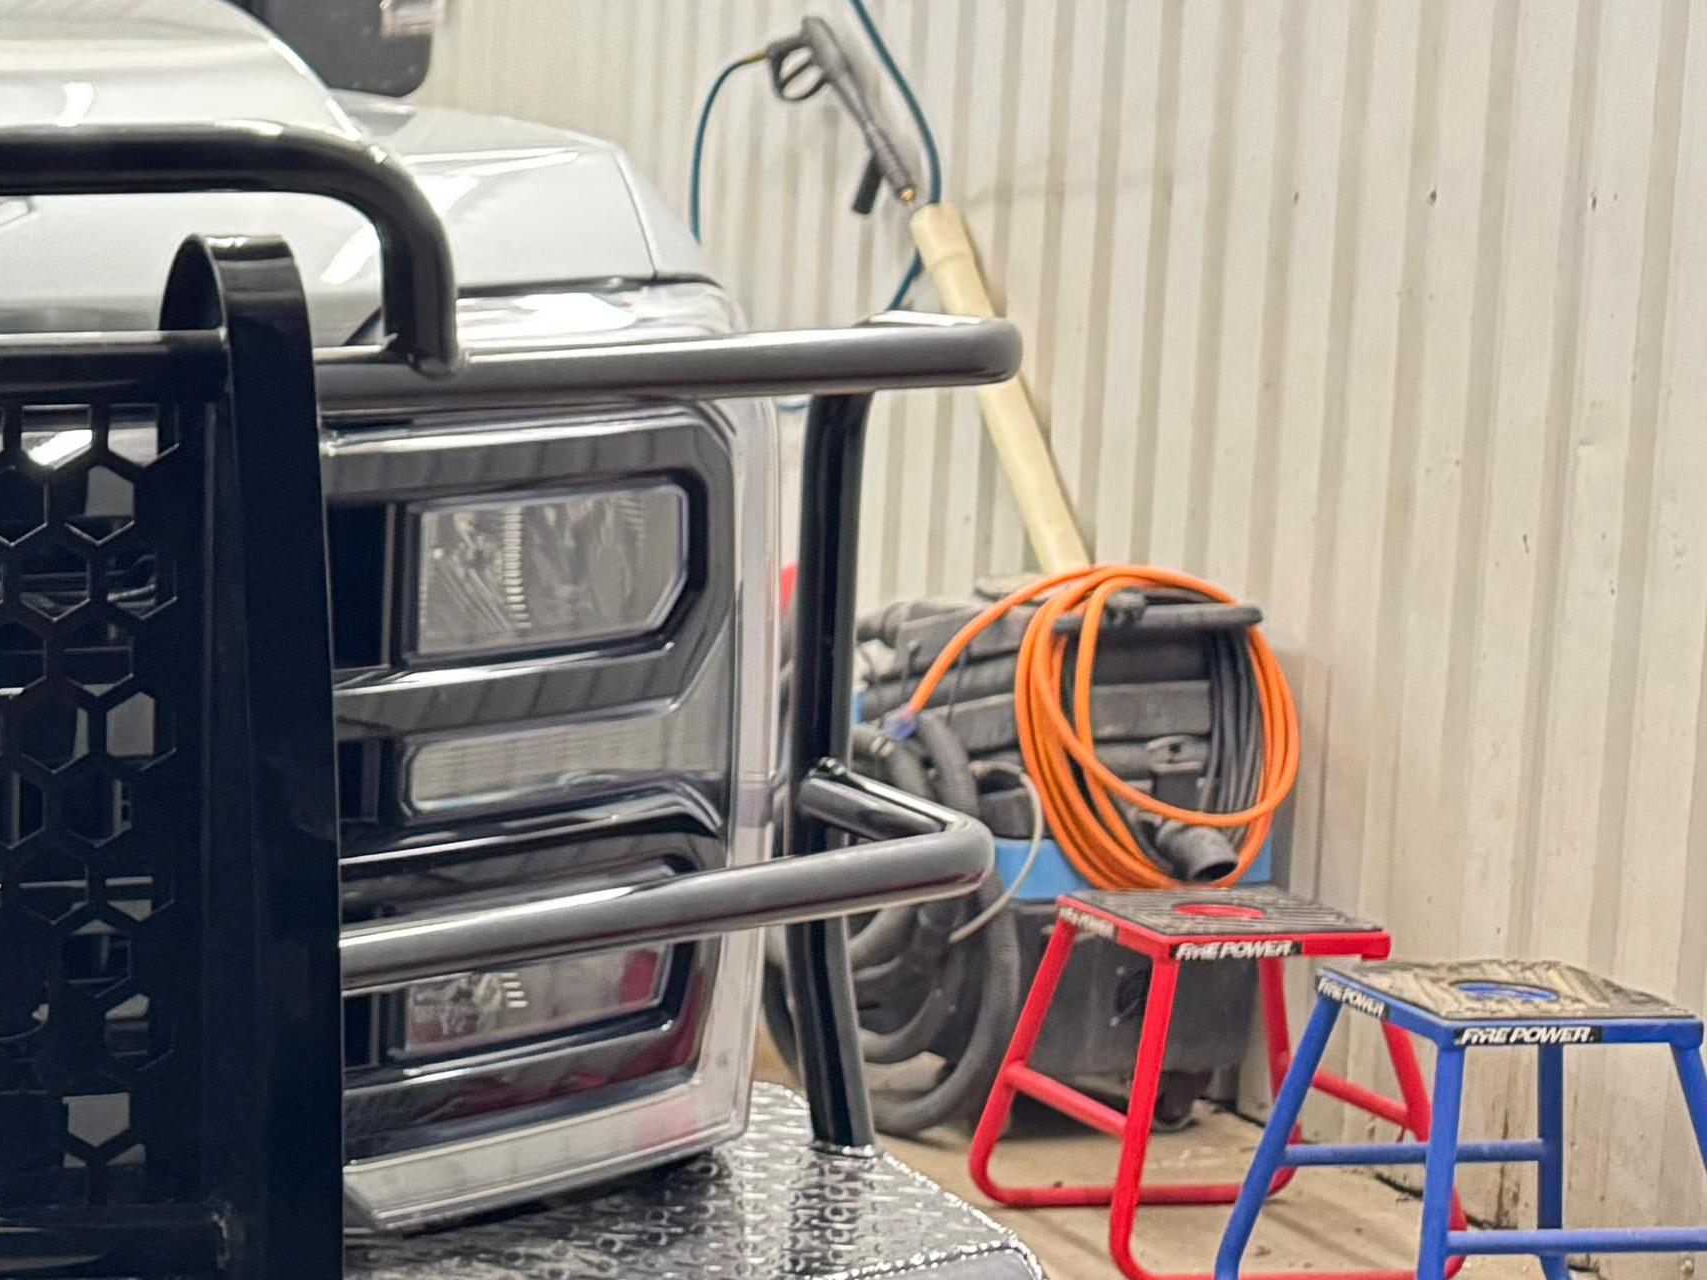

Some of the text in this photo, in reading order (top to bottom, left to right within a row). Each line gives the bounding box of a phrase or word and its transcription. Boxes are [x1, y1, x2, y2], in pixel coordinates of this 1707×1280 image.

[1219, 940, 1293, 960] POWER
[1342, 986, 1385, 1019] POWER
[1460, 1025, 1592, 1045] FIRE POWER
